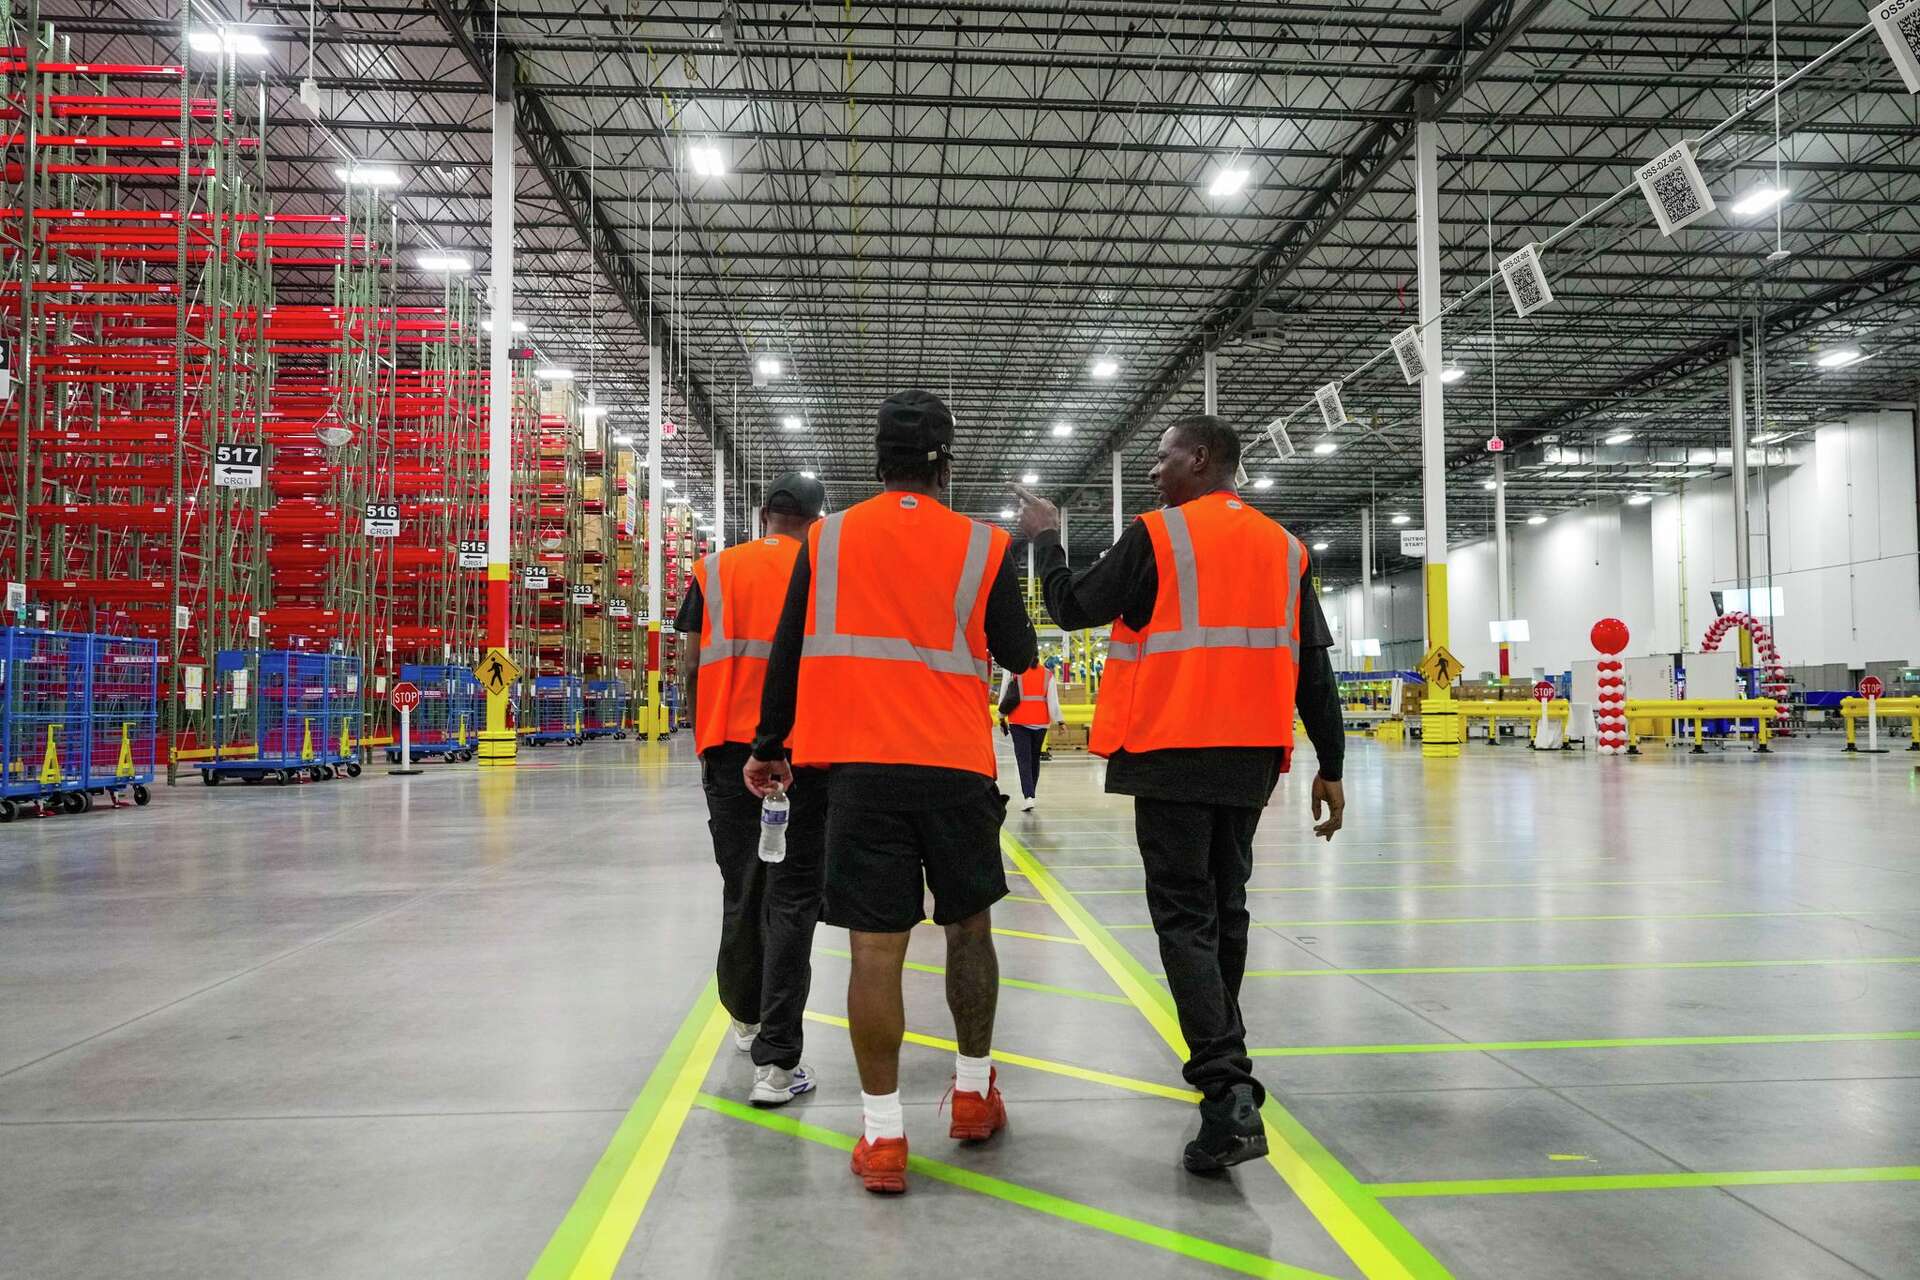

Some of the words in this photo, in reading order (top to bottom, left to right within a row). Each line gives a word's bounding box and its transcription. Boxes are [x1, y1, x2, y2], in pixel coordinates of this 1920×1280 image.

[1880, 0, 1914, 20] OSS-
[1641, 150, 1682, 180] OSS-DZ-083
[217, 446, 258, 463] 517
[367, 505, 397, 517] 516
[460, 541, 486, 552] 515
[526, 567, 546, 576] 514
[574, 585, 591, 593] 513
[1534, 687, 1554, 697] STOP
[1861, 684, 1881, 693] STOP
[395, 692, 417, 703] STOP
